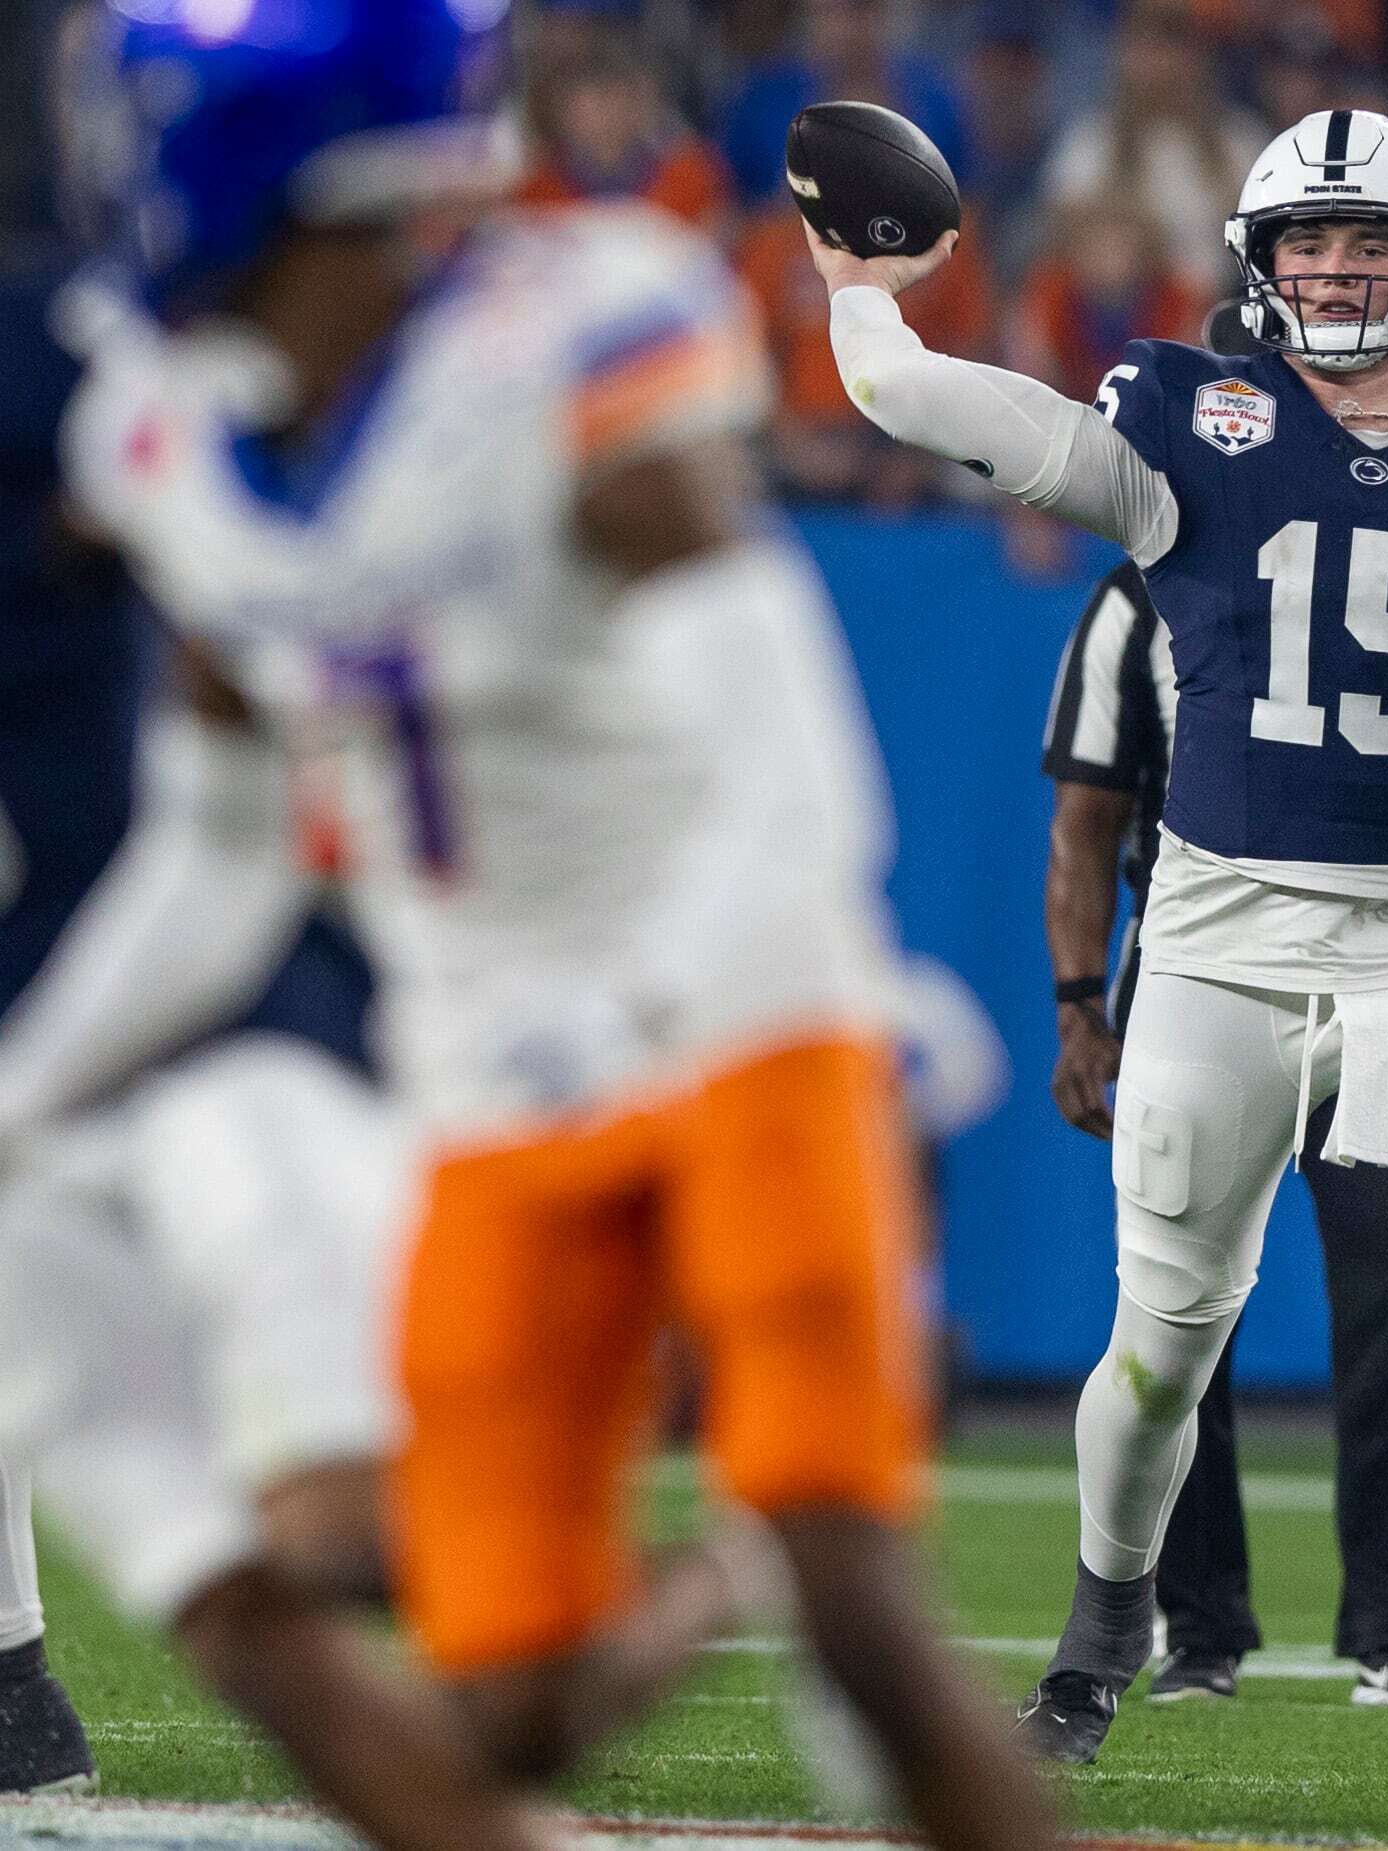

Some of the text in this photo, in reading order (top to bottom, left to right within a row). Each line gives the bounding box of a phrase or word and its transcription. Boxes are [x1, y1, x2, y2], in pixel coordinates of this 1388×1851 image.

[1304, 185, 1362, 194] PENN STATE
[1199, 408, 1271, 427] Fiesta Bowl
